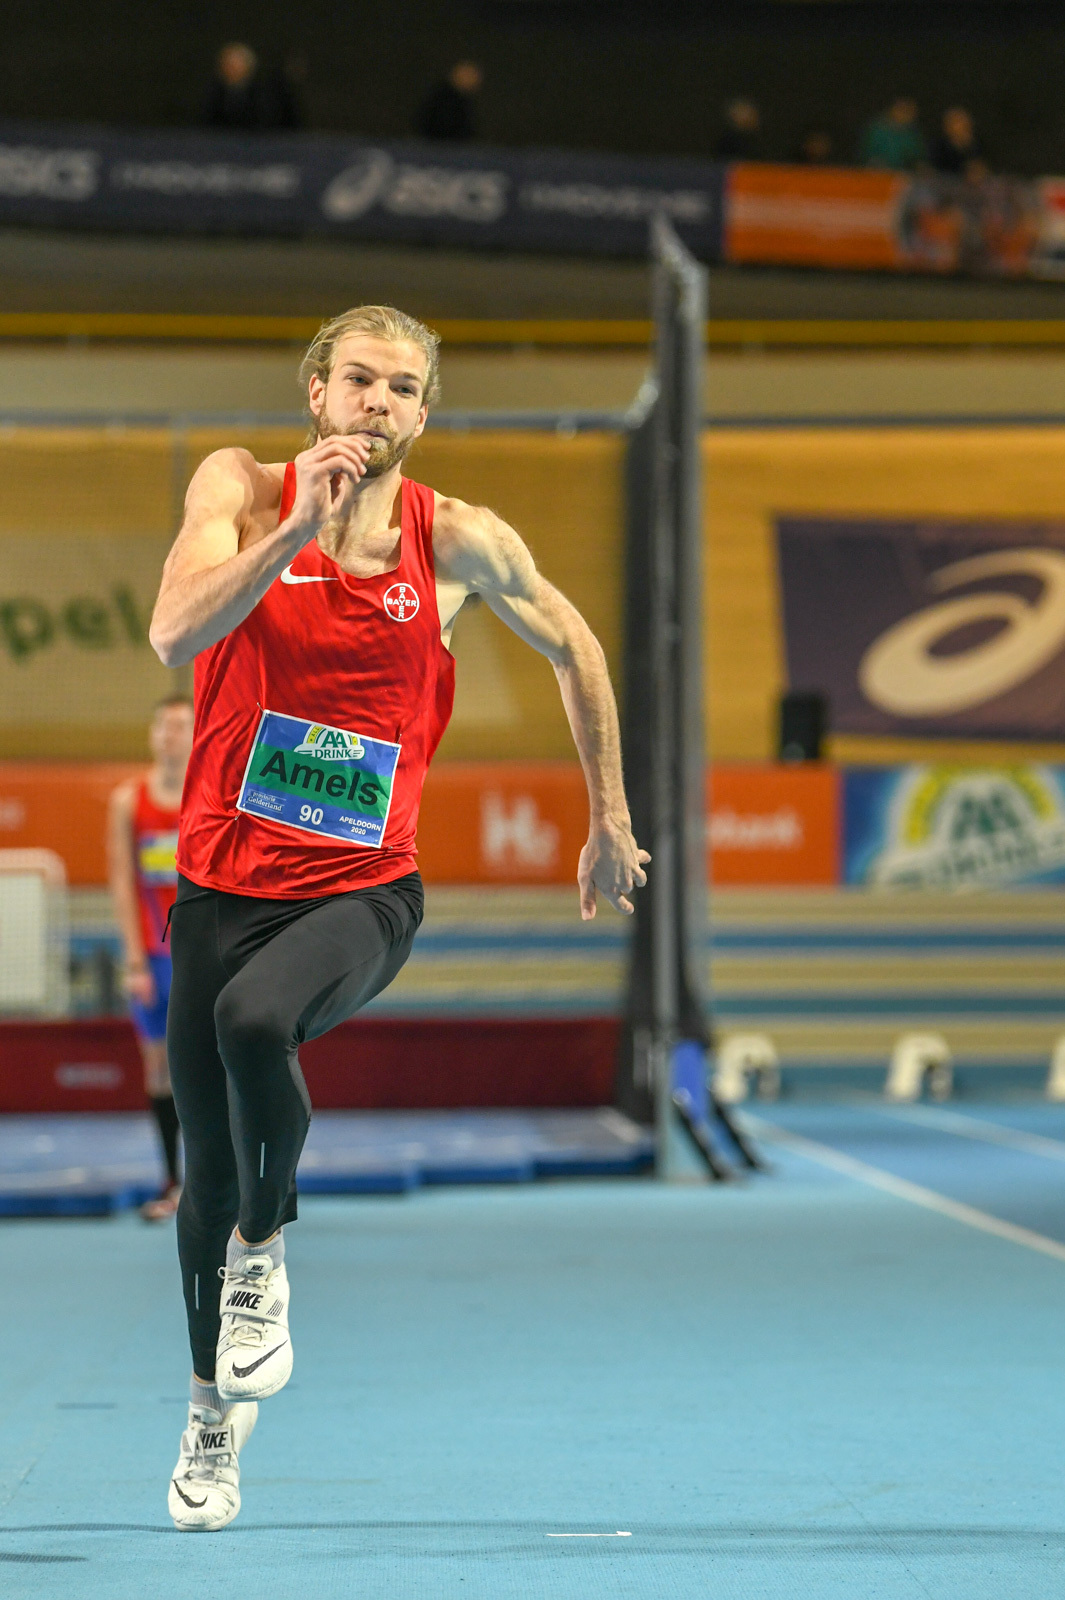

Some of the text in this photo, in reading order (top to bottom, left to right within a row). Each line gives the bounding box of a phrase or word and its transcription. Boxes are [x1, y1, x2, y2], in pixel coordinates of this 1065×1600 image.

[387, 598, 417, 607] BAYER
[320, 731, 348, 748] AA
[315, 749, 352, 759] DRINK
[259, 751, 379, 806] Amels
[248, 796, 282, 811] Gelderland
[299, 805, 324, 826] 90
[339, 816, 382, 831] APELDOORN
[351, 827, 366, 836] 2020
[226, 1290, 264, 1310] NIKE
